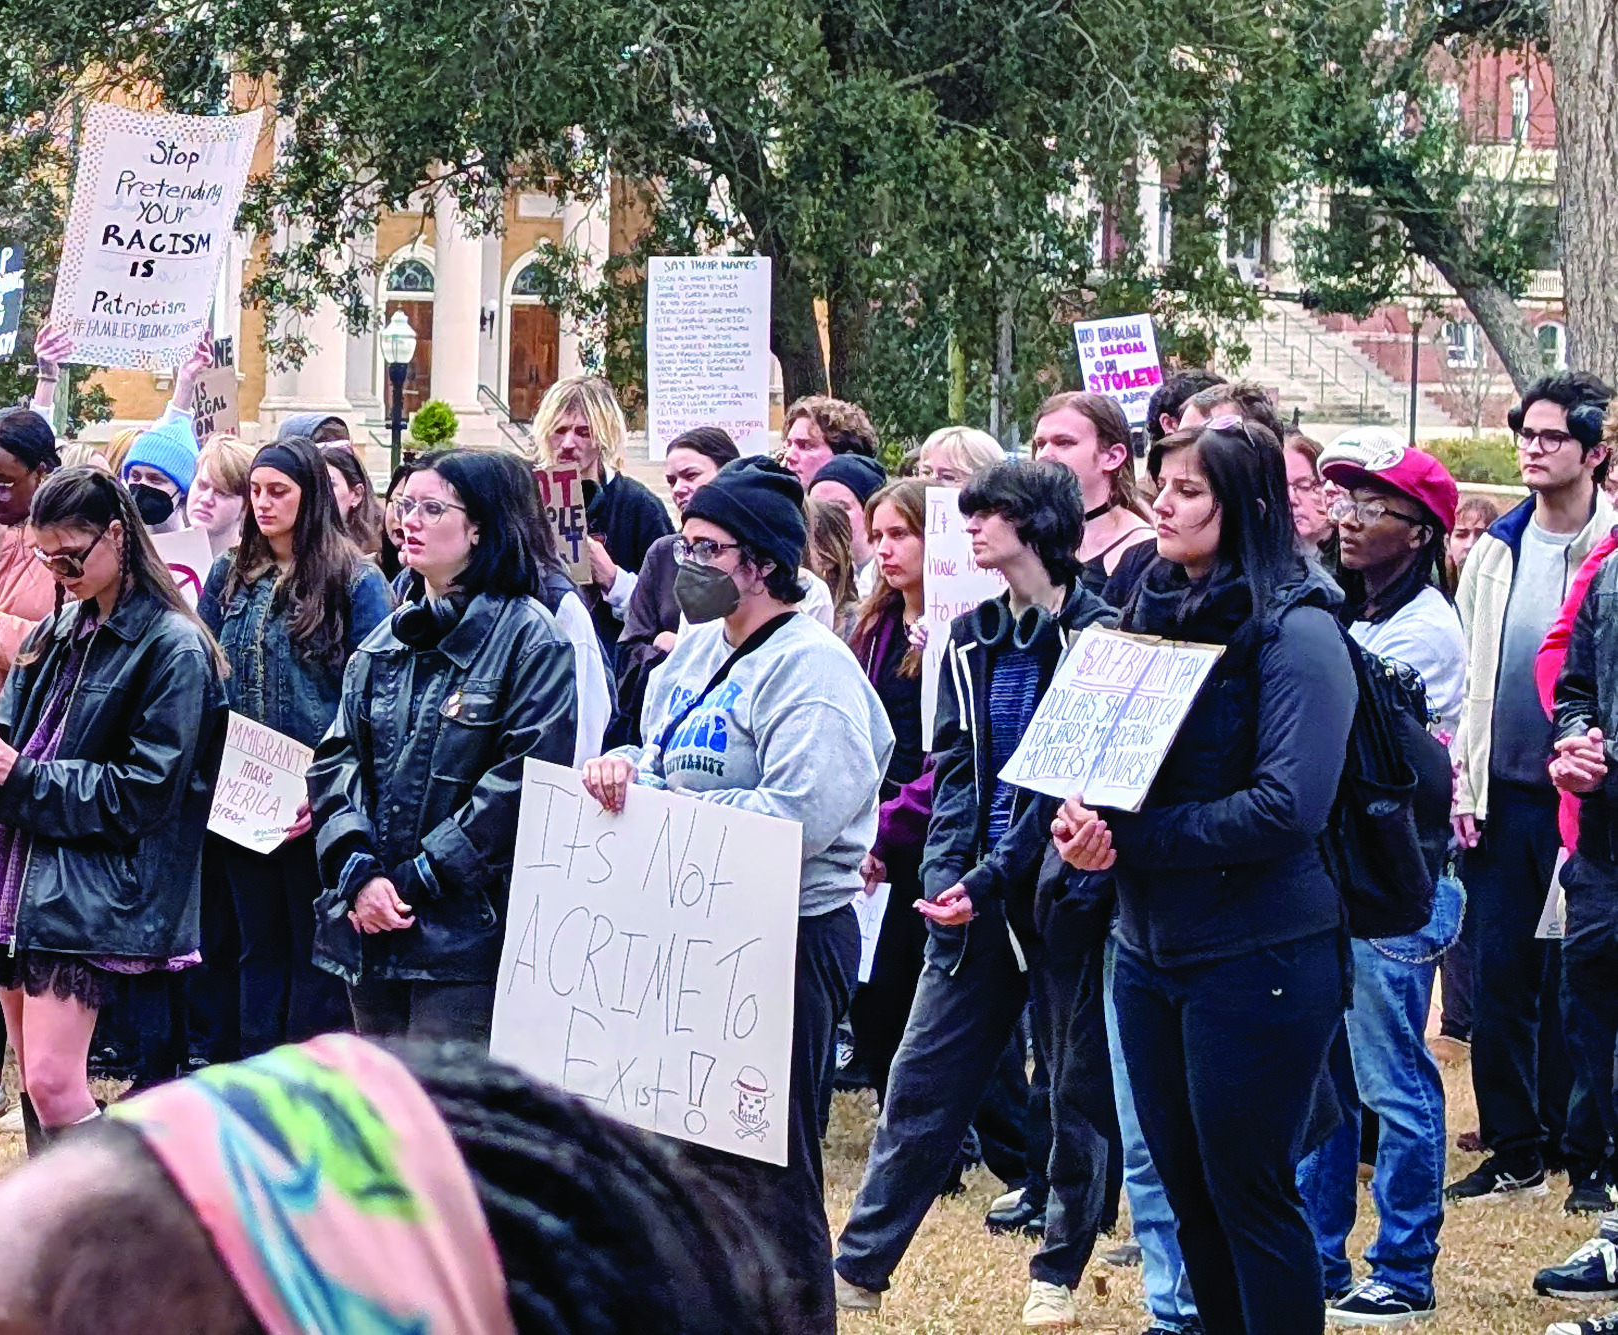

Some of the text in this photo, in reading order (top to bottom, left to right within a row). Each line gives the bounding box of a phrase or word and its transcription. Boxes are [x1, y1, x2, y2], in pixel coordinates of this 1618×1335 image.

[150, 140, 200, 173] Stop
[115, 170, 224, 206] Pretending
[102, 225, 211, 254] RACISM
[129, 260, 157, 278] IS
[663, 260, 685, 273] SAY
[92, 290, 186, 317] Patriotism
[1088, 365, 1162, 393] STOLEN
[929, 592, 950, 622] to
